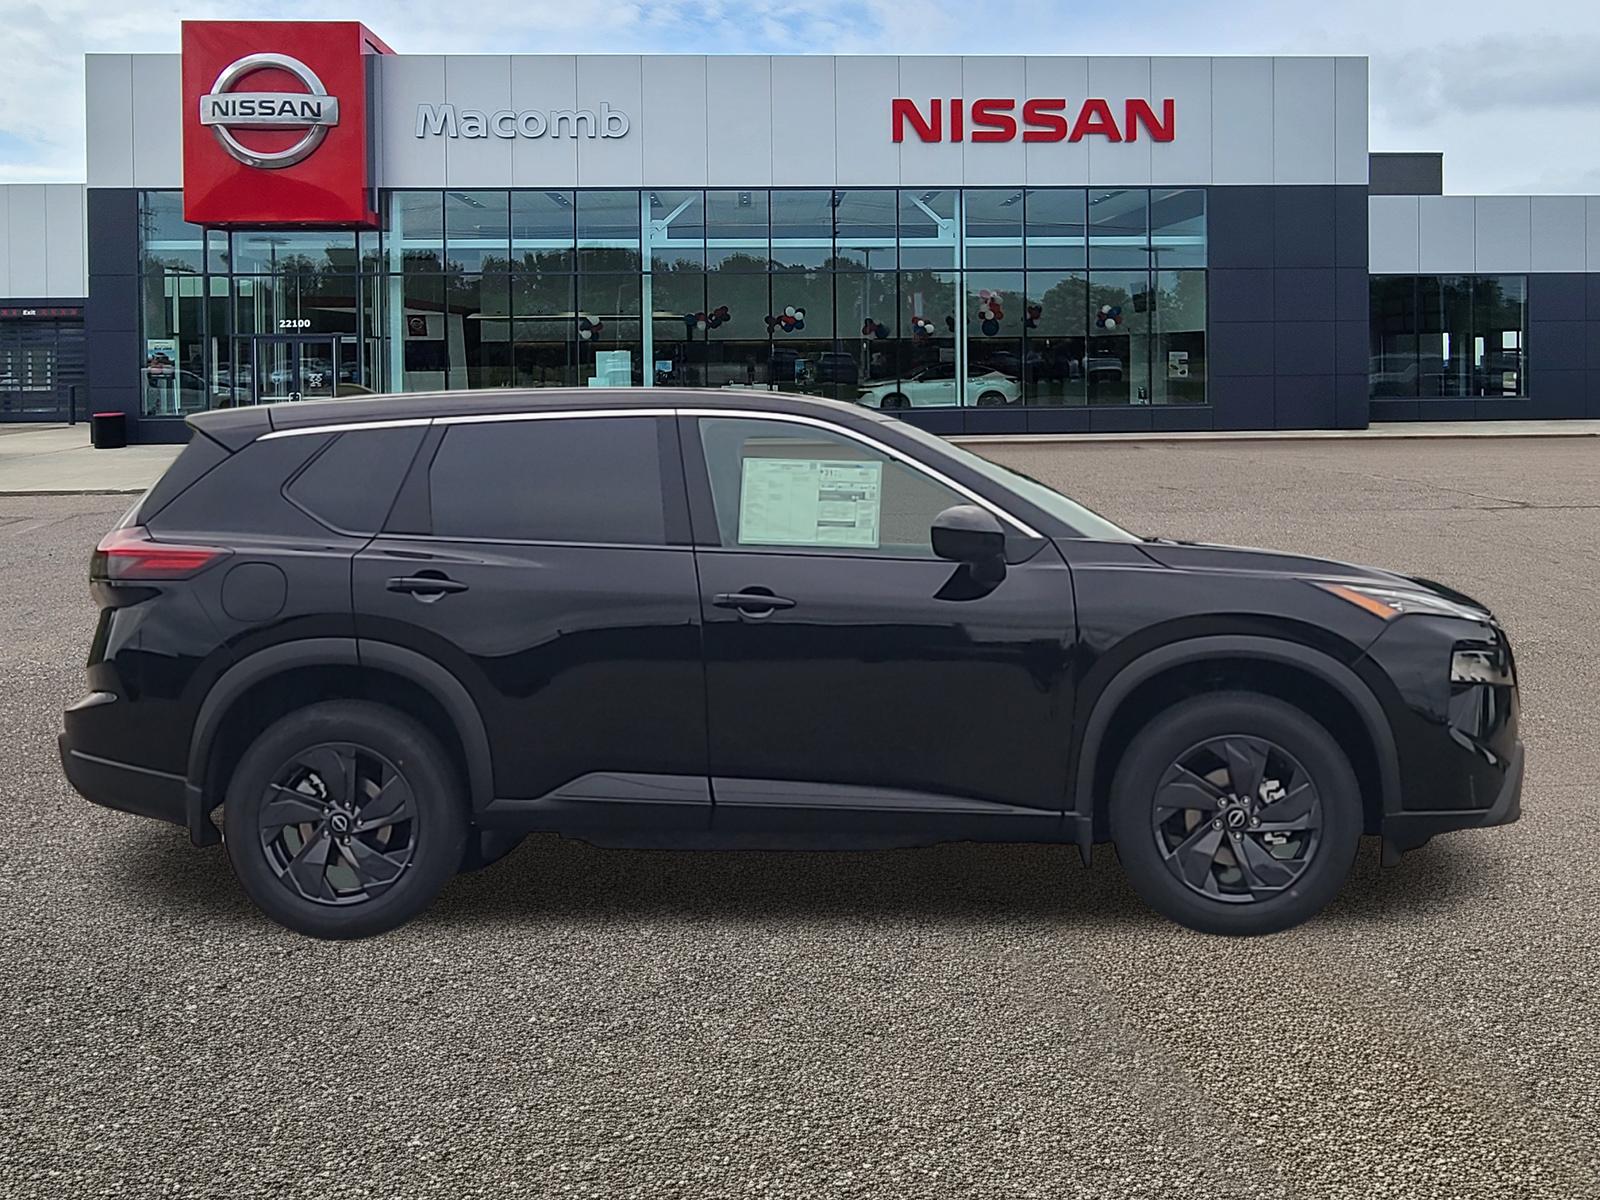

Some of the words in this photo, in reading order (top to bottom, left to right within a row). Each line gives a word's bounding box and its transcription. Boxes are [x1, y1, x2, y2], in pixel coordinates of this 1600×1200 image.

[212, 100, 322, 117] NISSAN
[415, 102, 630, 139] Macomb
[892, 98, 1175, 143] NISSAN
[279, 319, 311, 328] 22100
